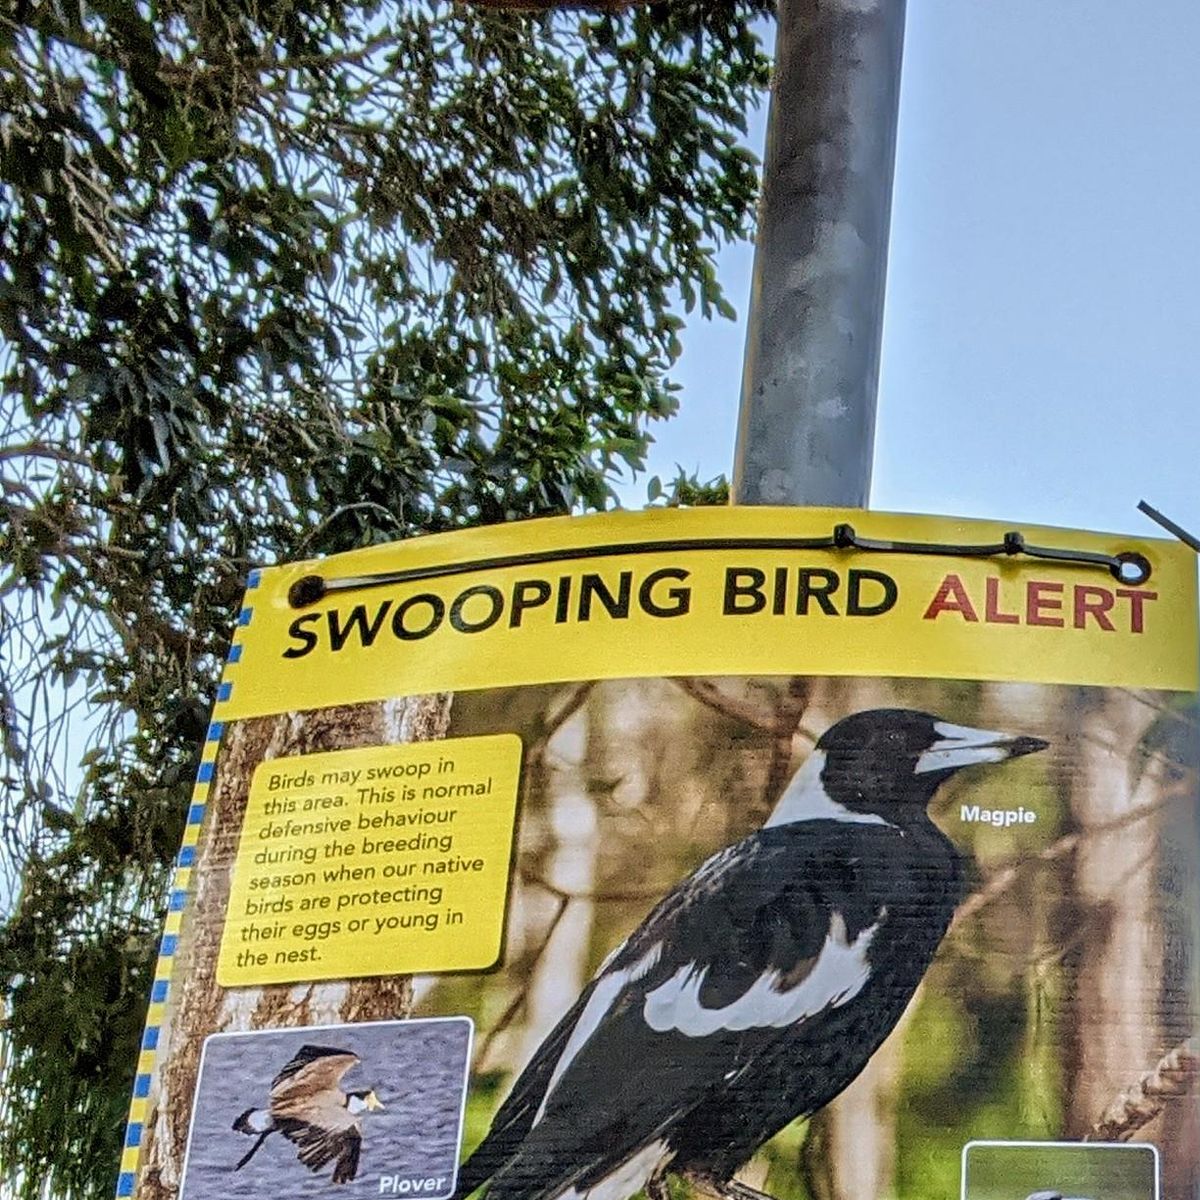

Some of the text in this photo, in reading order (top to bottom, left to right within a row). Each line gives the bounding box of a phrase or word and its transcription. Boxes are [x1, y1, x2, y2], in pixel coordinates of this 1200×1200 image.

[281, 566, 1158, 658] SWOOPING BIRD ALERT
[268, 758, 455, 791] Birds may swoop in
[264, 777, 492, 815] this area. This is normal
[258, 808, 458, 840] defensive behaviour
[960, 805, 1036, 826] Magpie
[254, 834, 452, 866] during the breeding
[249, 855, 484, 890] season when our native
[245, 885, 443, 915] birds are protecting
[240, 908, 463, 942] their eggs or young in
[236, 946, 322, 968] the nest.
[379, 1174, 446, 1193] Plover
